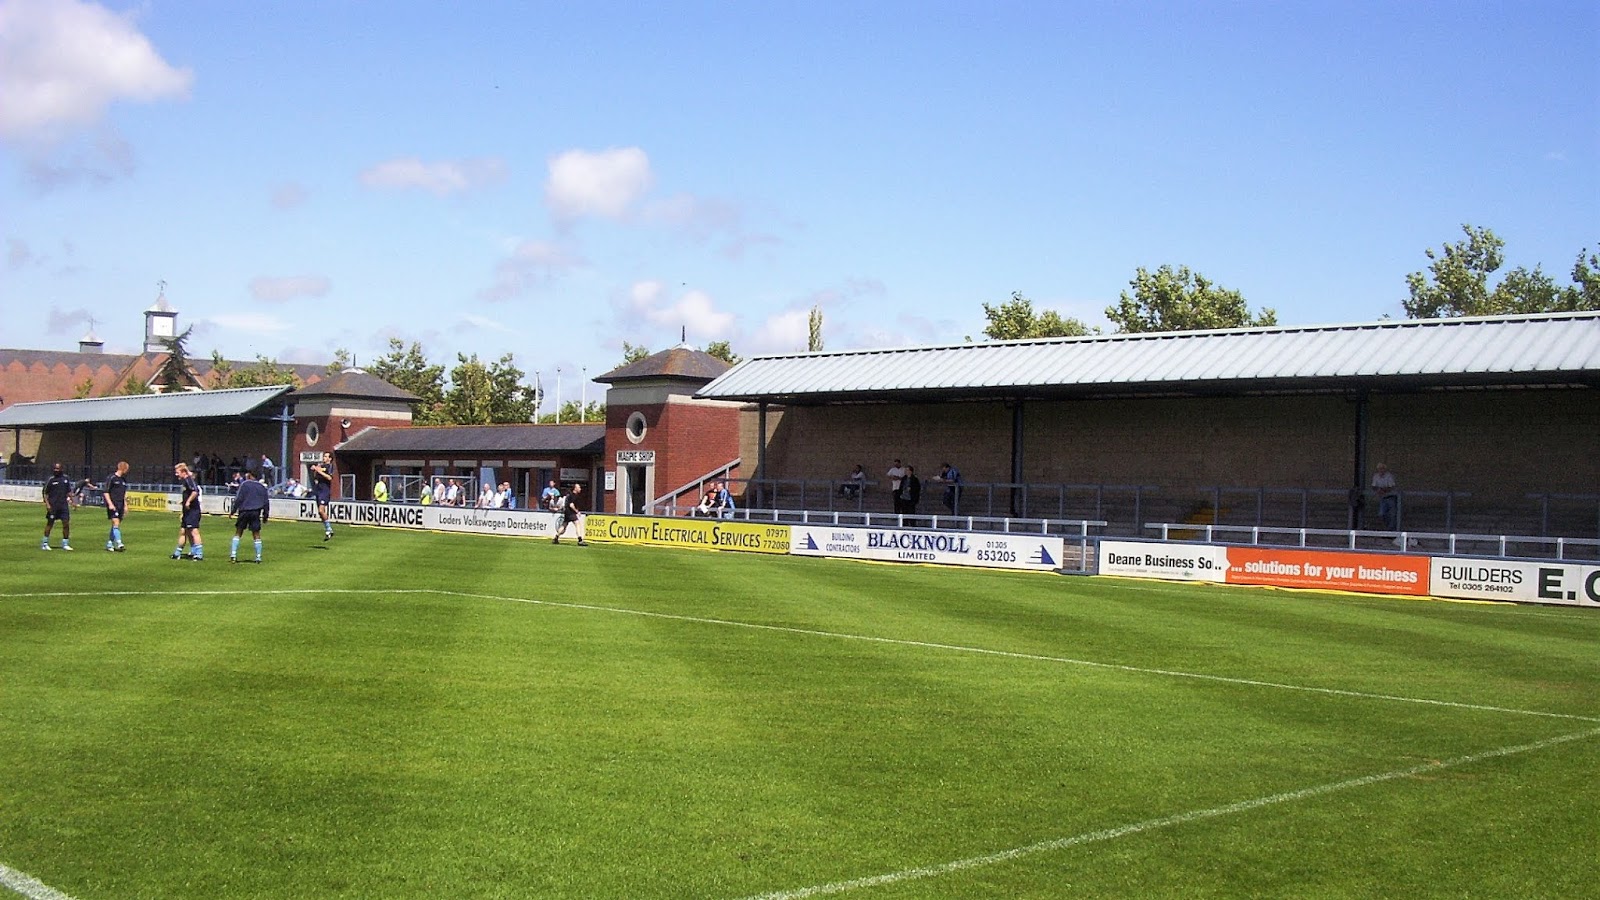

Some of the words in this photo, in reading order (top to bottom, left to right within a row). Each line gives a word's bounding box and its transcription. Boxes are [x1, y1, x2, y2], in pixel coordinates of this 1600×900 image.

[618, 452, 637, 461] MAGPIE
[639, 452, 654, 462] SHOP
[300, 502, 316, 518] P.J.
[322, 503, 352, 520] IKEN
[356, 506, 423, 525] INSURANCE
[439, 514, 462, 525] Loders
[464, 514, 506, 530] Volkswagen
[508, 518, 547, 531] Dorchester
[586, 518, 606, 527] 01305
[609, 520, 650, 539] COUNTY
[652, 522, 708, 544] ELECTRICAL
[712, 526, 761, 548] SERVICES
[766, 529, 788, 538] 07971
[832, 533, 855, 542] BUILDING
[763, 540, 790, 550] 772080
[826, 544, 860, 553] CONTRACTORS
[867, 532, 970, 554] BLACKNOLL
[898, 552, 936, 561] LIMITED
[977, 550, 1016, 562] 853205
[1108, 552, 1141, 566] Deane
[1145, 554, 1194, 569] Business
[1244, 560, 1301, 576] solutions
[1304, 562, 1322, 577] for
[1325, 566, 1355, 580] your
[1358, 566, 1418, 583] business
[1441, 566, 1522, 584] BUILDERS
[1462, 583, 1482, 591] 0305
[1484, 584, 1514, 593] 264102
